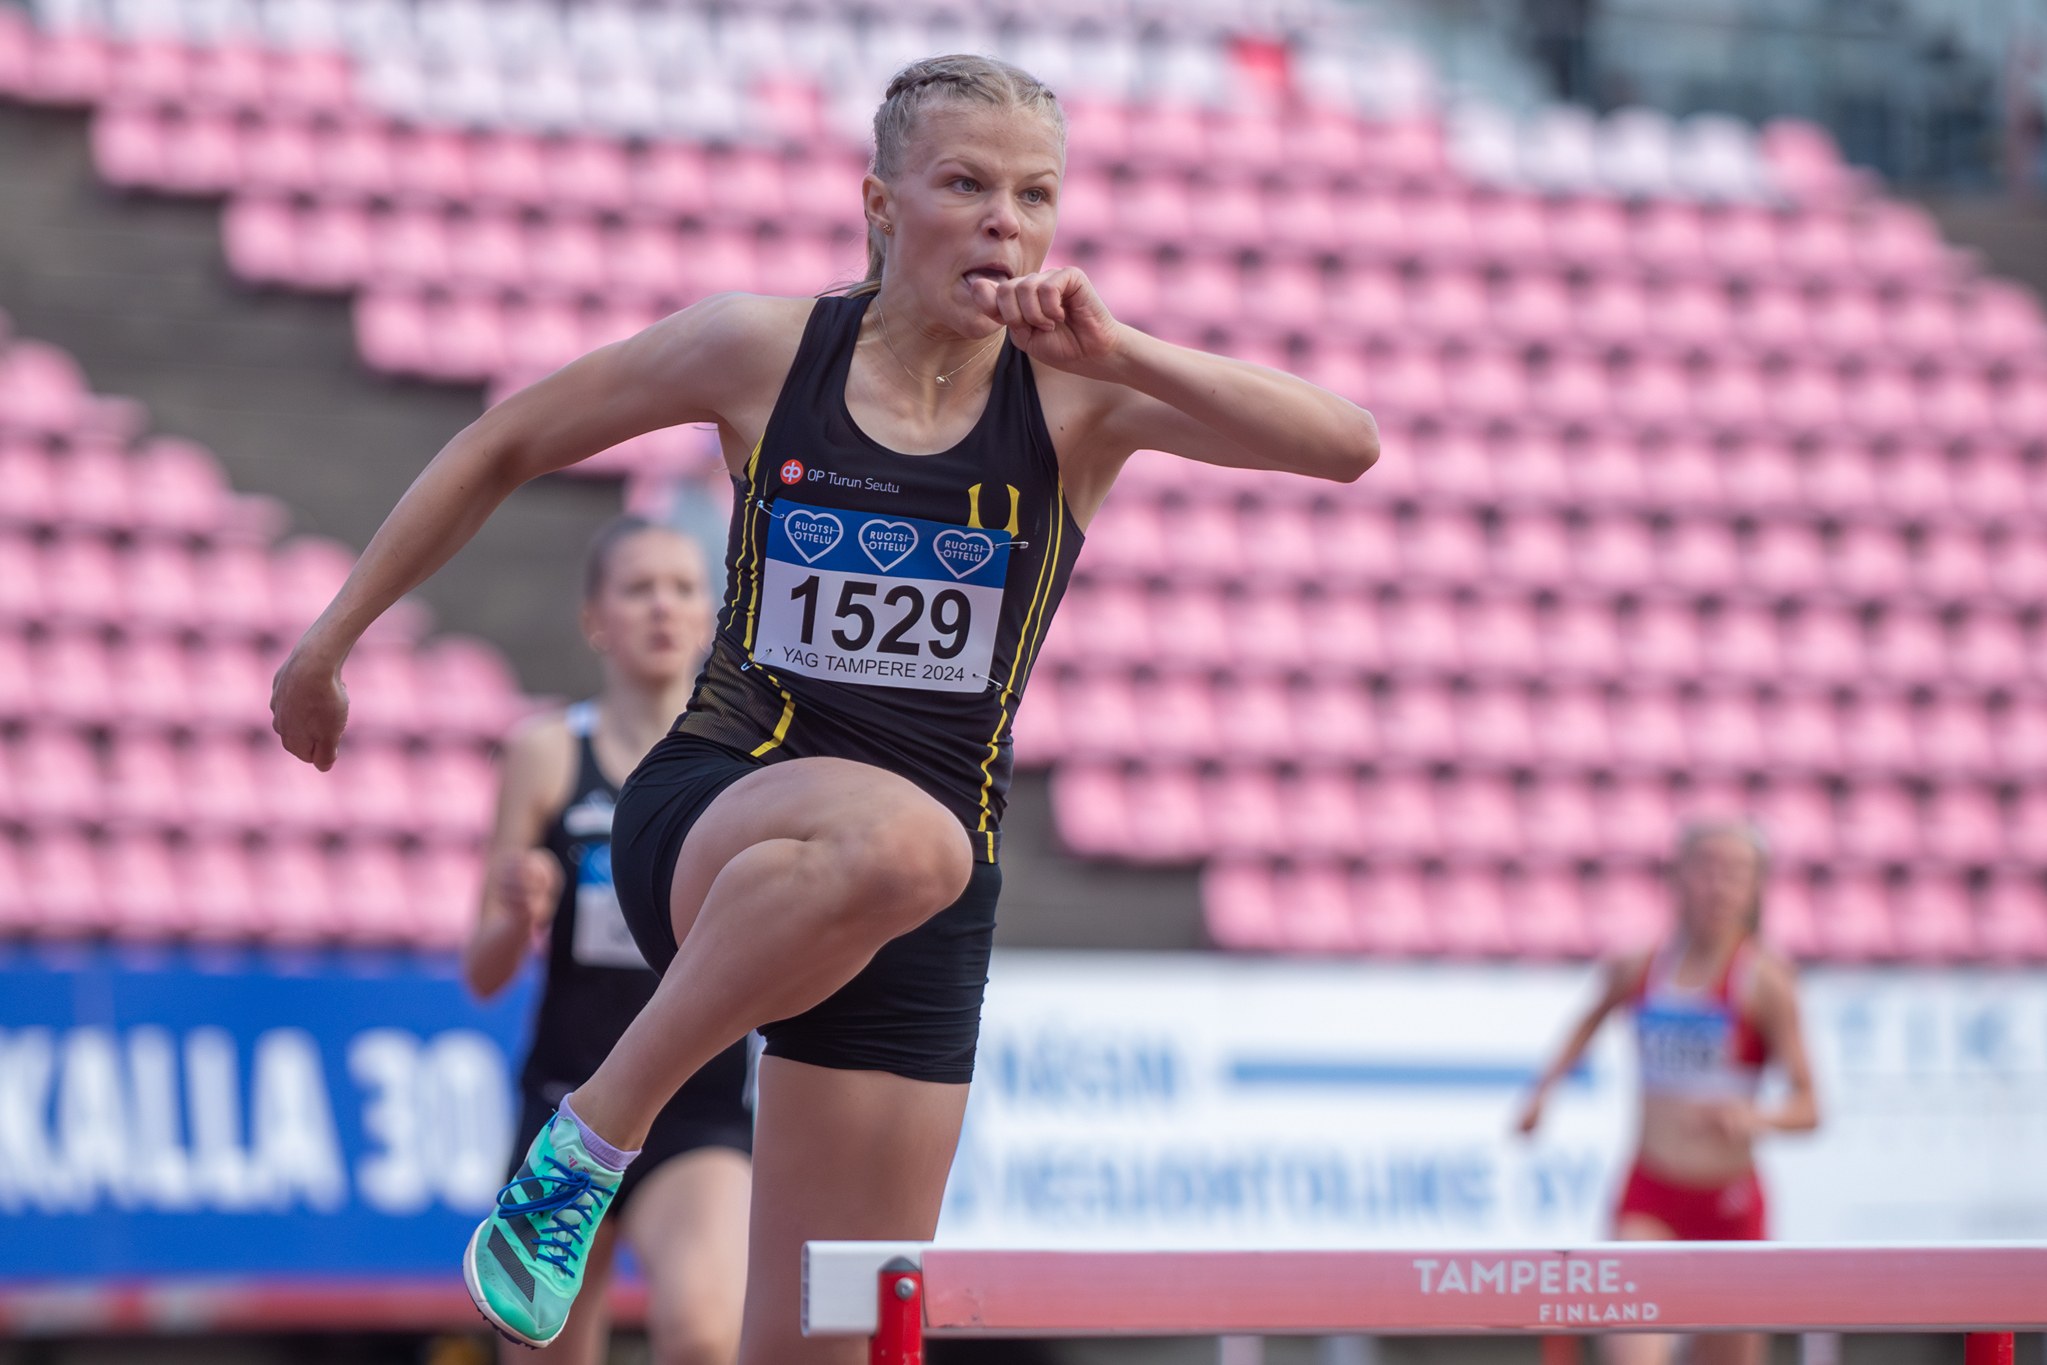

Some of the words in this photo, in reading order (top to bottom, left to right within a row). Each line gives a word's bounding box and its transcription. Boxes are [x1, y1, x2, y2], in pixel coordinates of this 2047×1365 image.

[807, 468, 825, 482] OP
[828, 471, 862, 488] Turun
[864, 477, 900, 493] Seutu
[790, 574, 971, 660] 1529
[783, 646, 818, 668] YAG
[825, 655, 917, 678] TAMPERE
[922, 664, 964, 682] 2024
[1539, 1302, 1659, 1322] FINLAND
